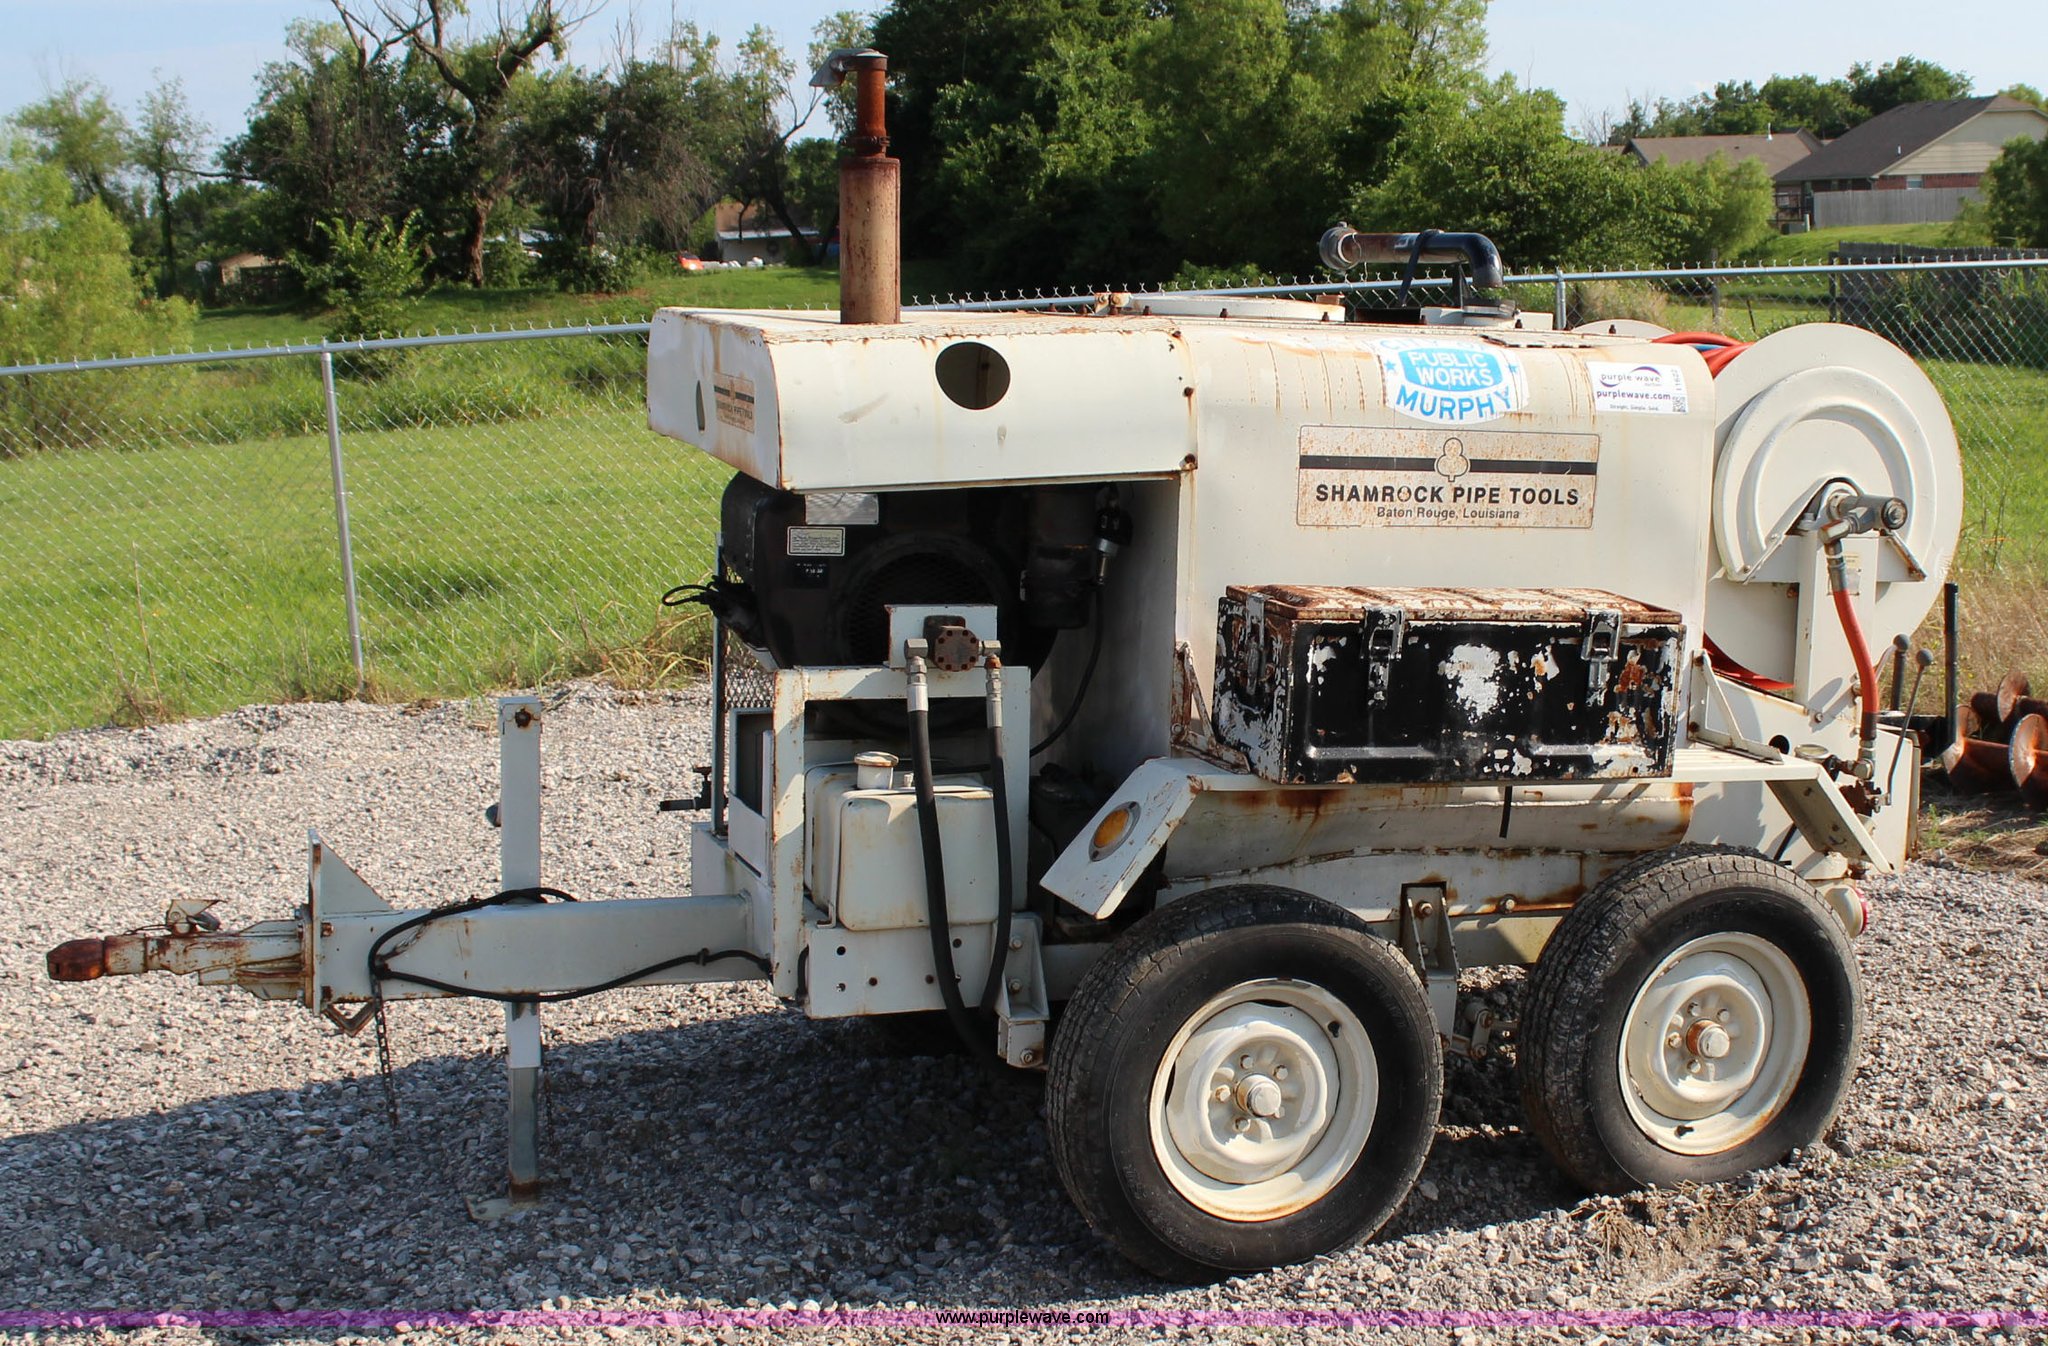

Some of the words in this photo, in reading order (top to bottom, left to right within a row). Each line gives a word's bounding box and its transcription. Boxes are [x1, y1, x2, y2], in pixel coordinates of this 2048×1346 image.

[1407, 351, 1488, 368] PUBLIC
[1415, 367, 1494, 387] WORKS
[1601, 373, 1632, 382] purple
[1396, 384, 1511, 421] MURPHY
[1596, 389, 1671, 400] purplewave.com
[1316, 484, 1444, 503] SHAMROCK
[1452, 486, 1500, 504] PIPE
[1509, 488, 1579, 505] TOOLS
[1377, 506, 1413, 518] Baton
[1417, 507, 1459, 522] Rouge,
[1463, 508, 1520, 520] Louisiana
